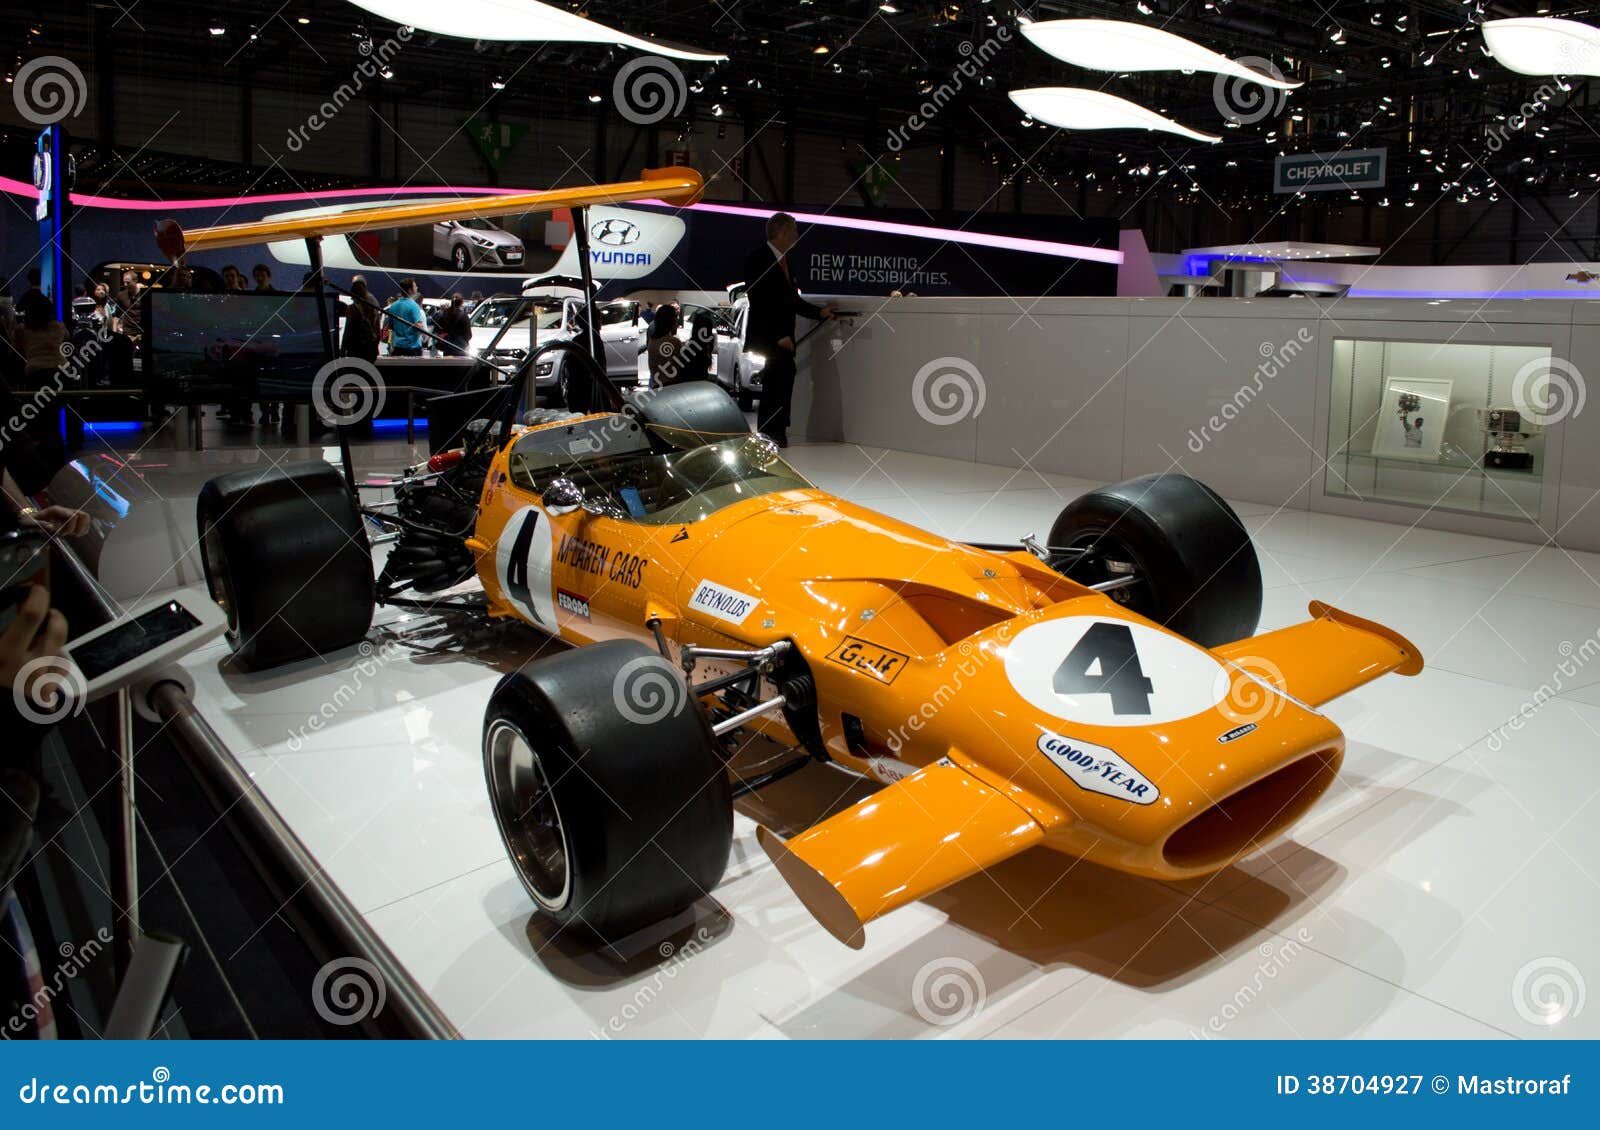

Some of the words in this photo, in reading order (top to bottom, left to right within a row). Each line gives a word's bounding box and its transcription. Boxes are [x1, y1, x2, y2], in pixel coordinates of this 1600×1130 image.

[1287, 161, 1372, 180] CHEVROLET
[588, 250, 652, 265] YUNDAI
[810, 253, 845, 267] NEW
[810, 267, 844, 281] NEW
[848, 268, 951, 286] POSSIBILITIES.
[507, 509, 545, 626] 4
[608, 551, 648, 589] CARS
[558, 592, 589, 614] FERODO
[695, 585, 751, 617] REYNOLDS
[839, 643, 899, 675] Gulf
[1052, 621, 1155, 716] 4
[1045, 738, 1093, 768] GOOD
[1099, 763, 1150, 798] YEAR
